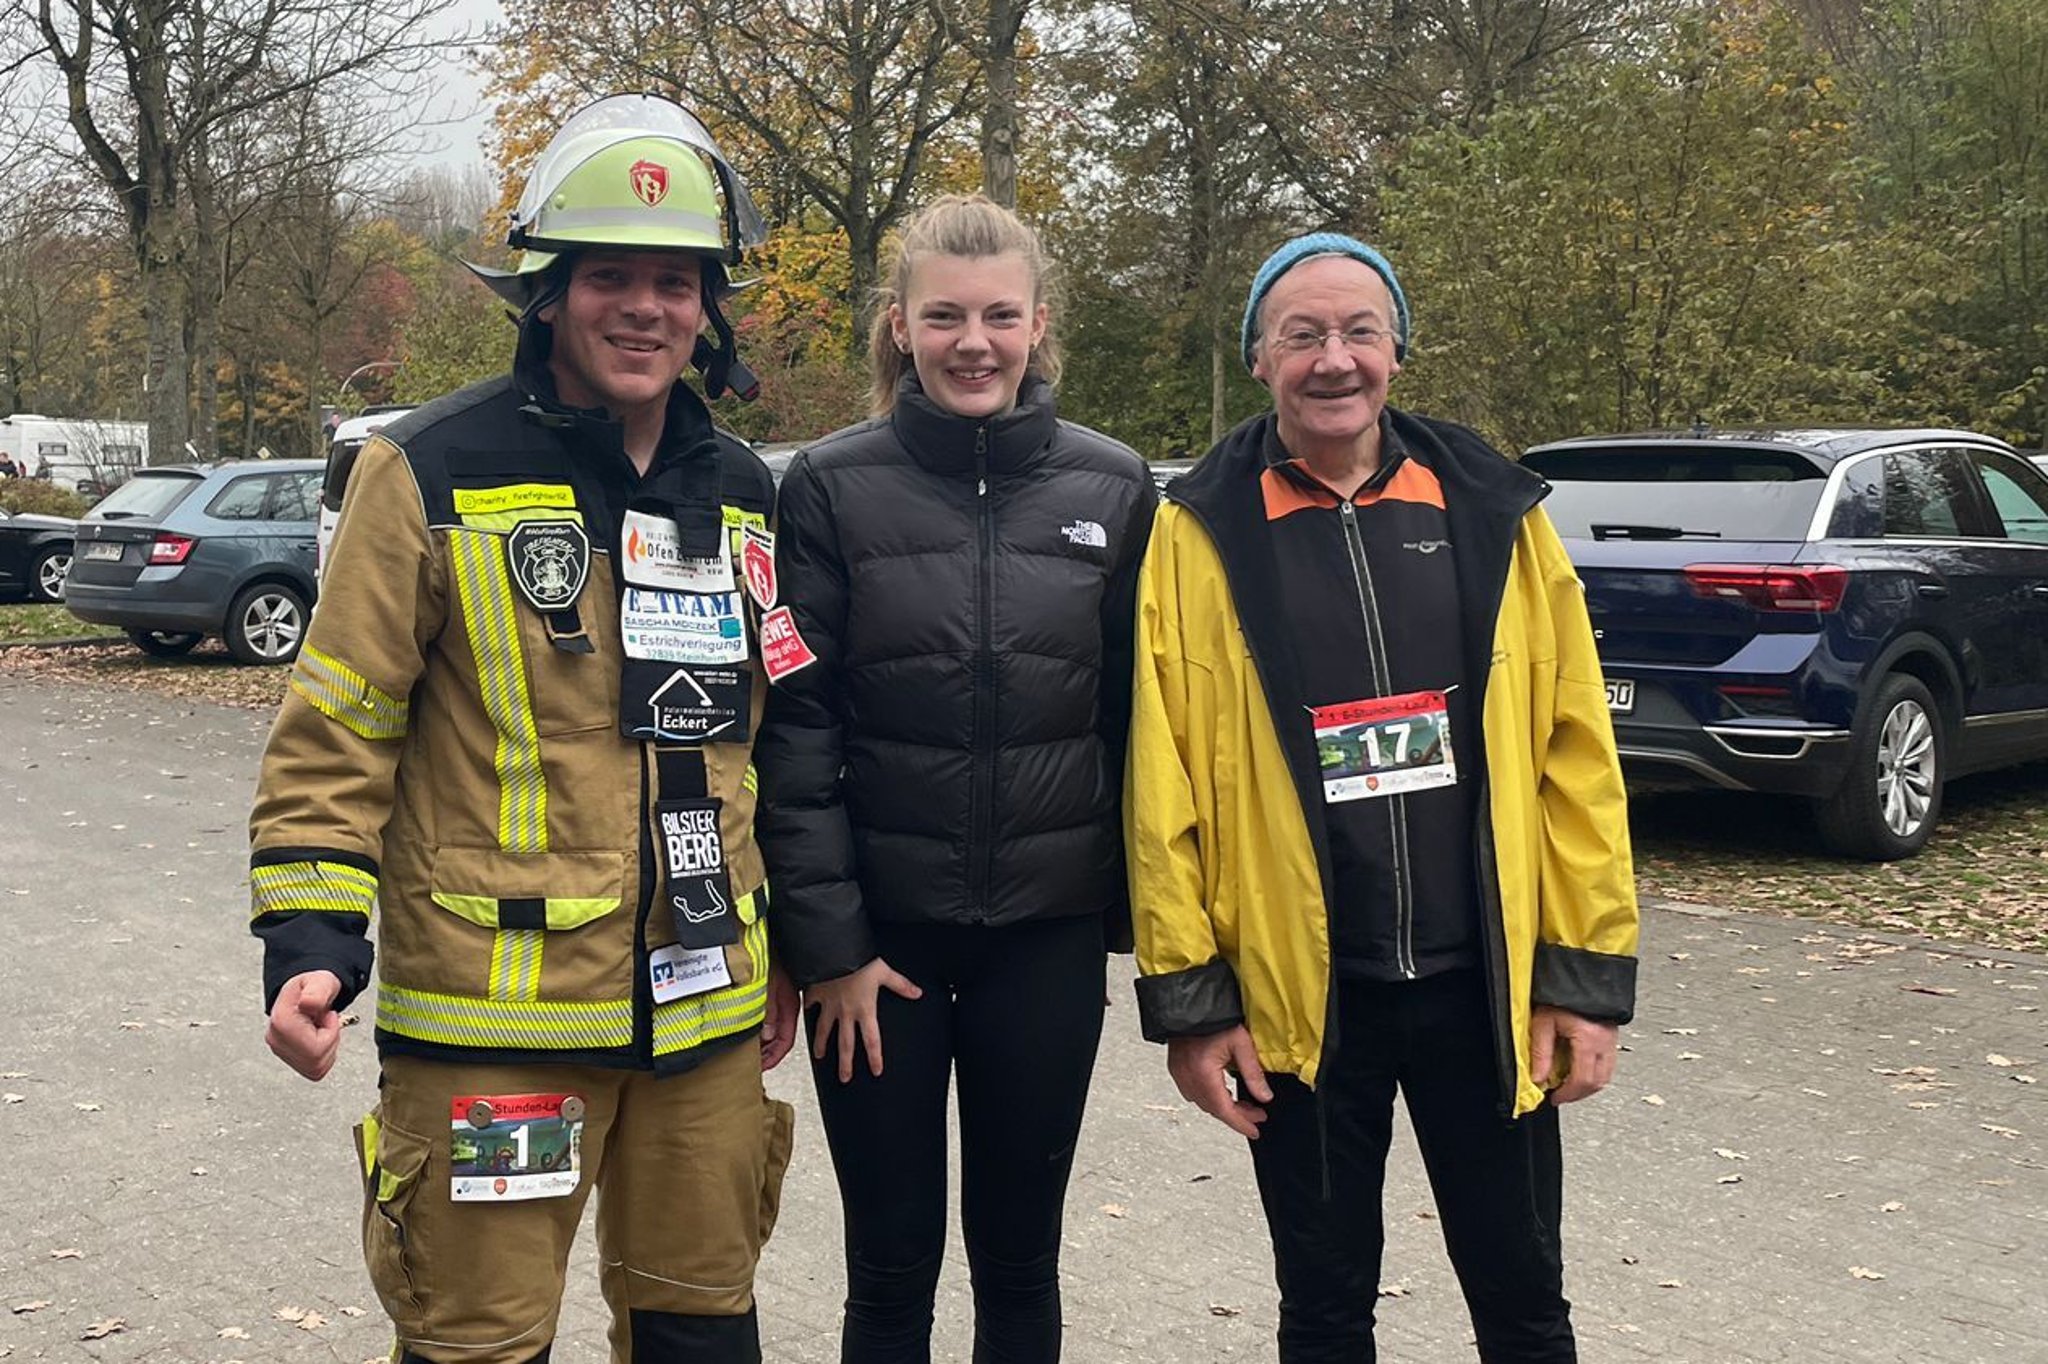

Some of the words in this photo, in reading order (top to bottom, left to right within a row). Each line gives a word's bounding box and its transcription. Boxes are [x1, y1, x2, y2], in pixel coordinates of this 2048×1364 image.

[648, 543, 675, 561] Ofen
[763, 615, 793, 645] EWE
[640, 634, 742, 653] Estrichverlegung
[662, 713, 708, 730] Eckert
[1358, 723, 1411, 767] 17
[662, 809, 716, 835] BILSTER
[667, 831, 721, 872] BERG
[495, 1101, 561, 1114] Stunden-La
[510, 1125, 529, 1167] 1
